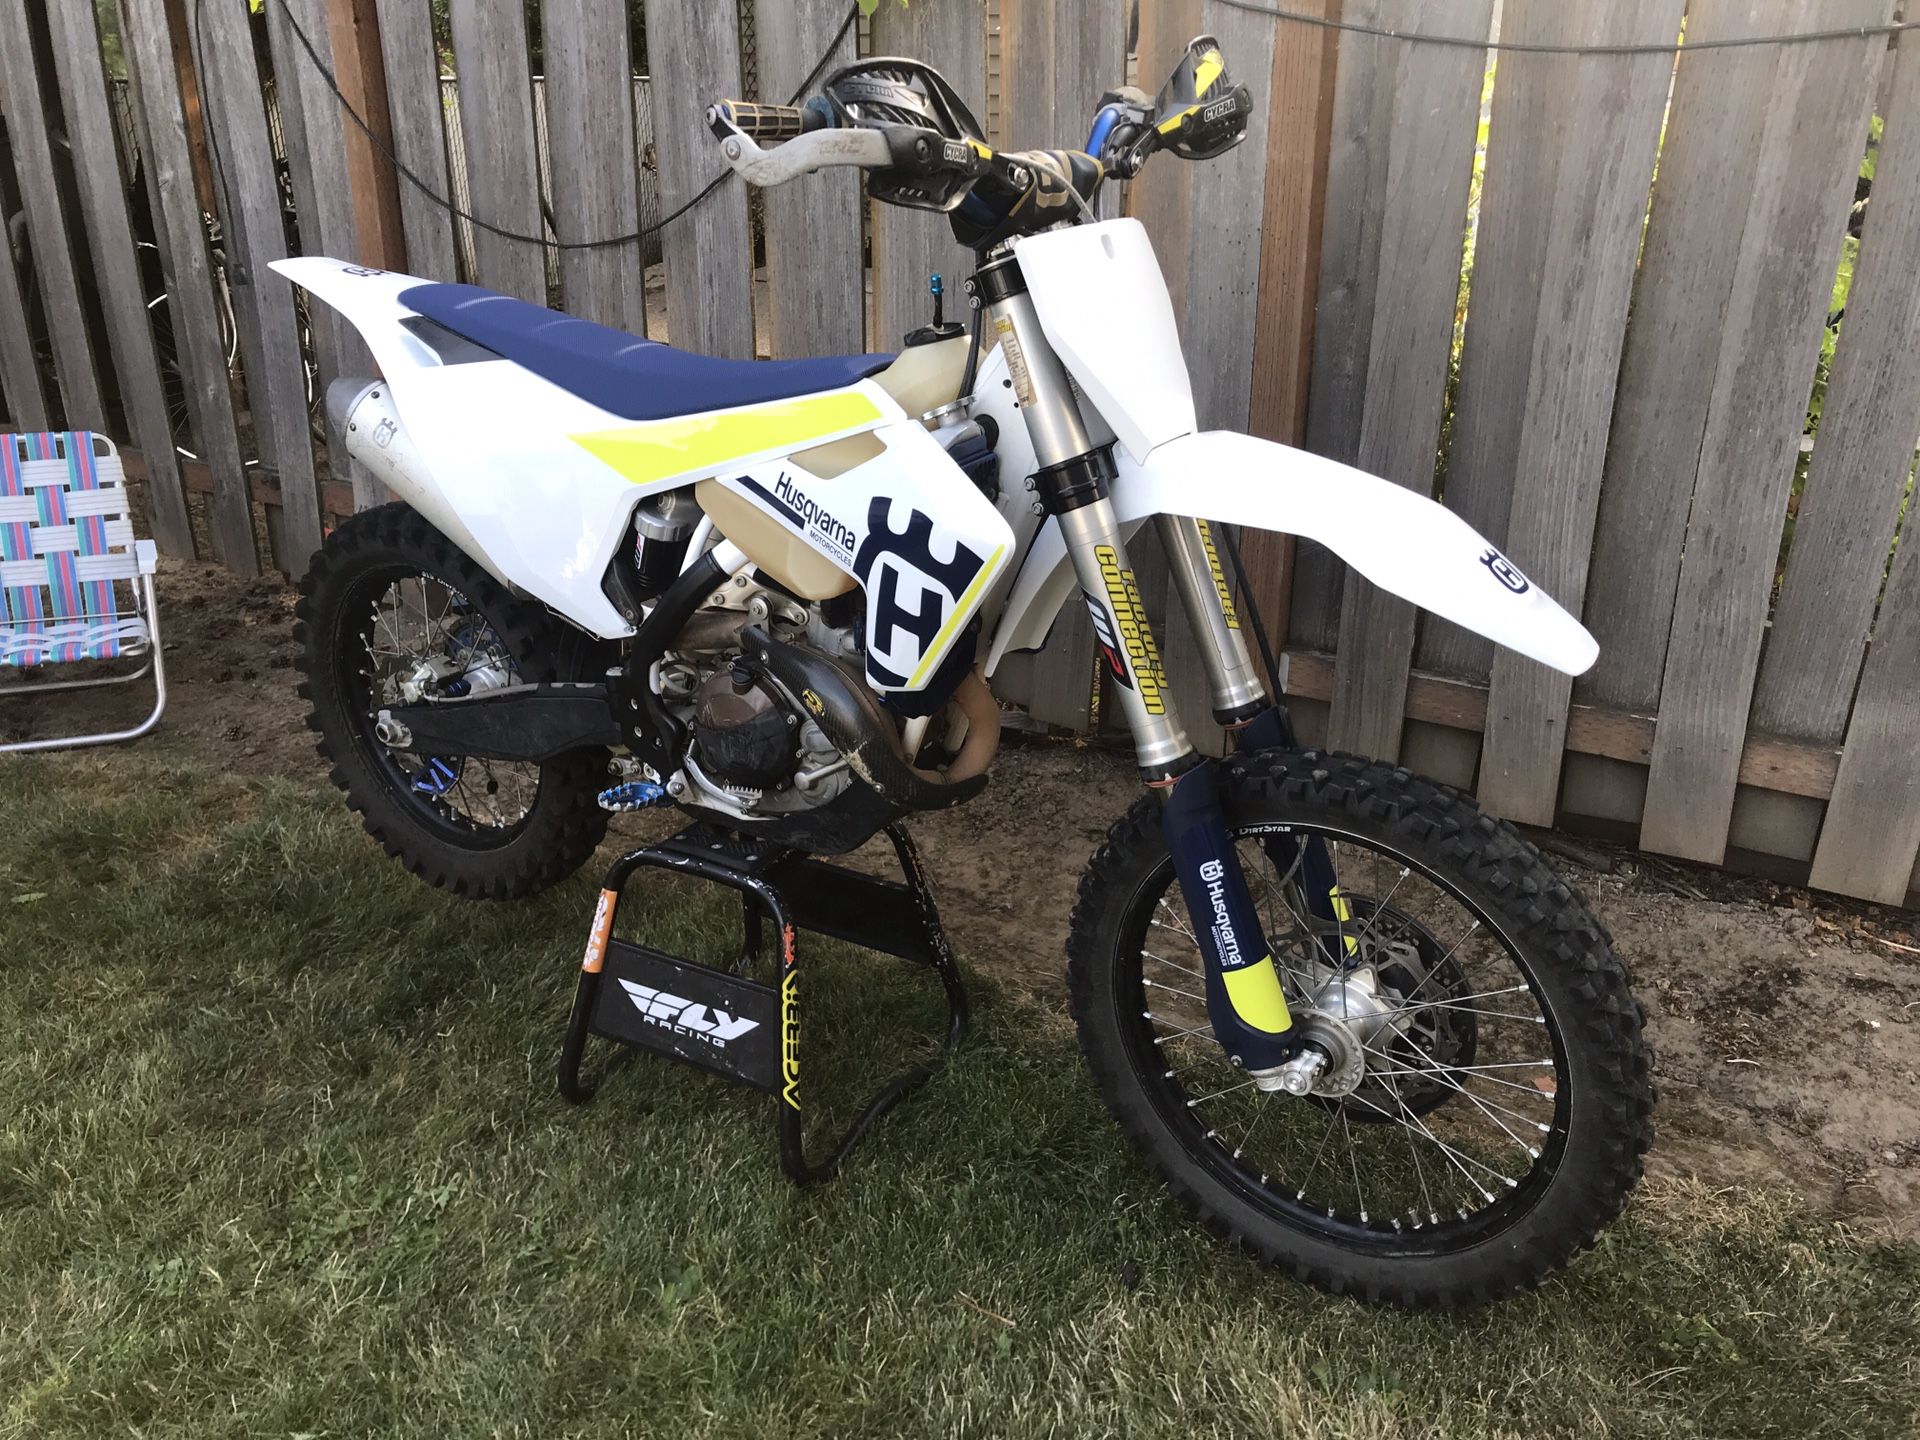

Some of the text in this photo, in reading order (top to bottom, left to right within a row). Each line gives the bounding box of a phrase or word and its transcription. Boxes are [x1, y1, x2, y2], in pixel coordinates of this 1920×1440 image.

[1204, 98, 1236, 122] CYCRA
[944, 144, 967, 163] CYCRA
[775, 471, 856, 552] Husqvarna
[809, 530, 852, 567] MOTORCYCLES
[1094, 545, 1166, 715] Connection
[1207, 881, 1243, 965] Husqvarna
[1211, 926, 1227, 967] MOTORCYCLES
[617, 978, 760, 1041] FLY
[643, 1015, 725, 1048] RACING
